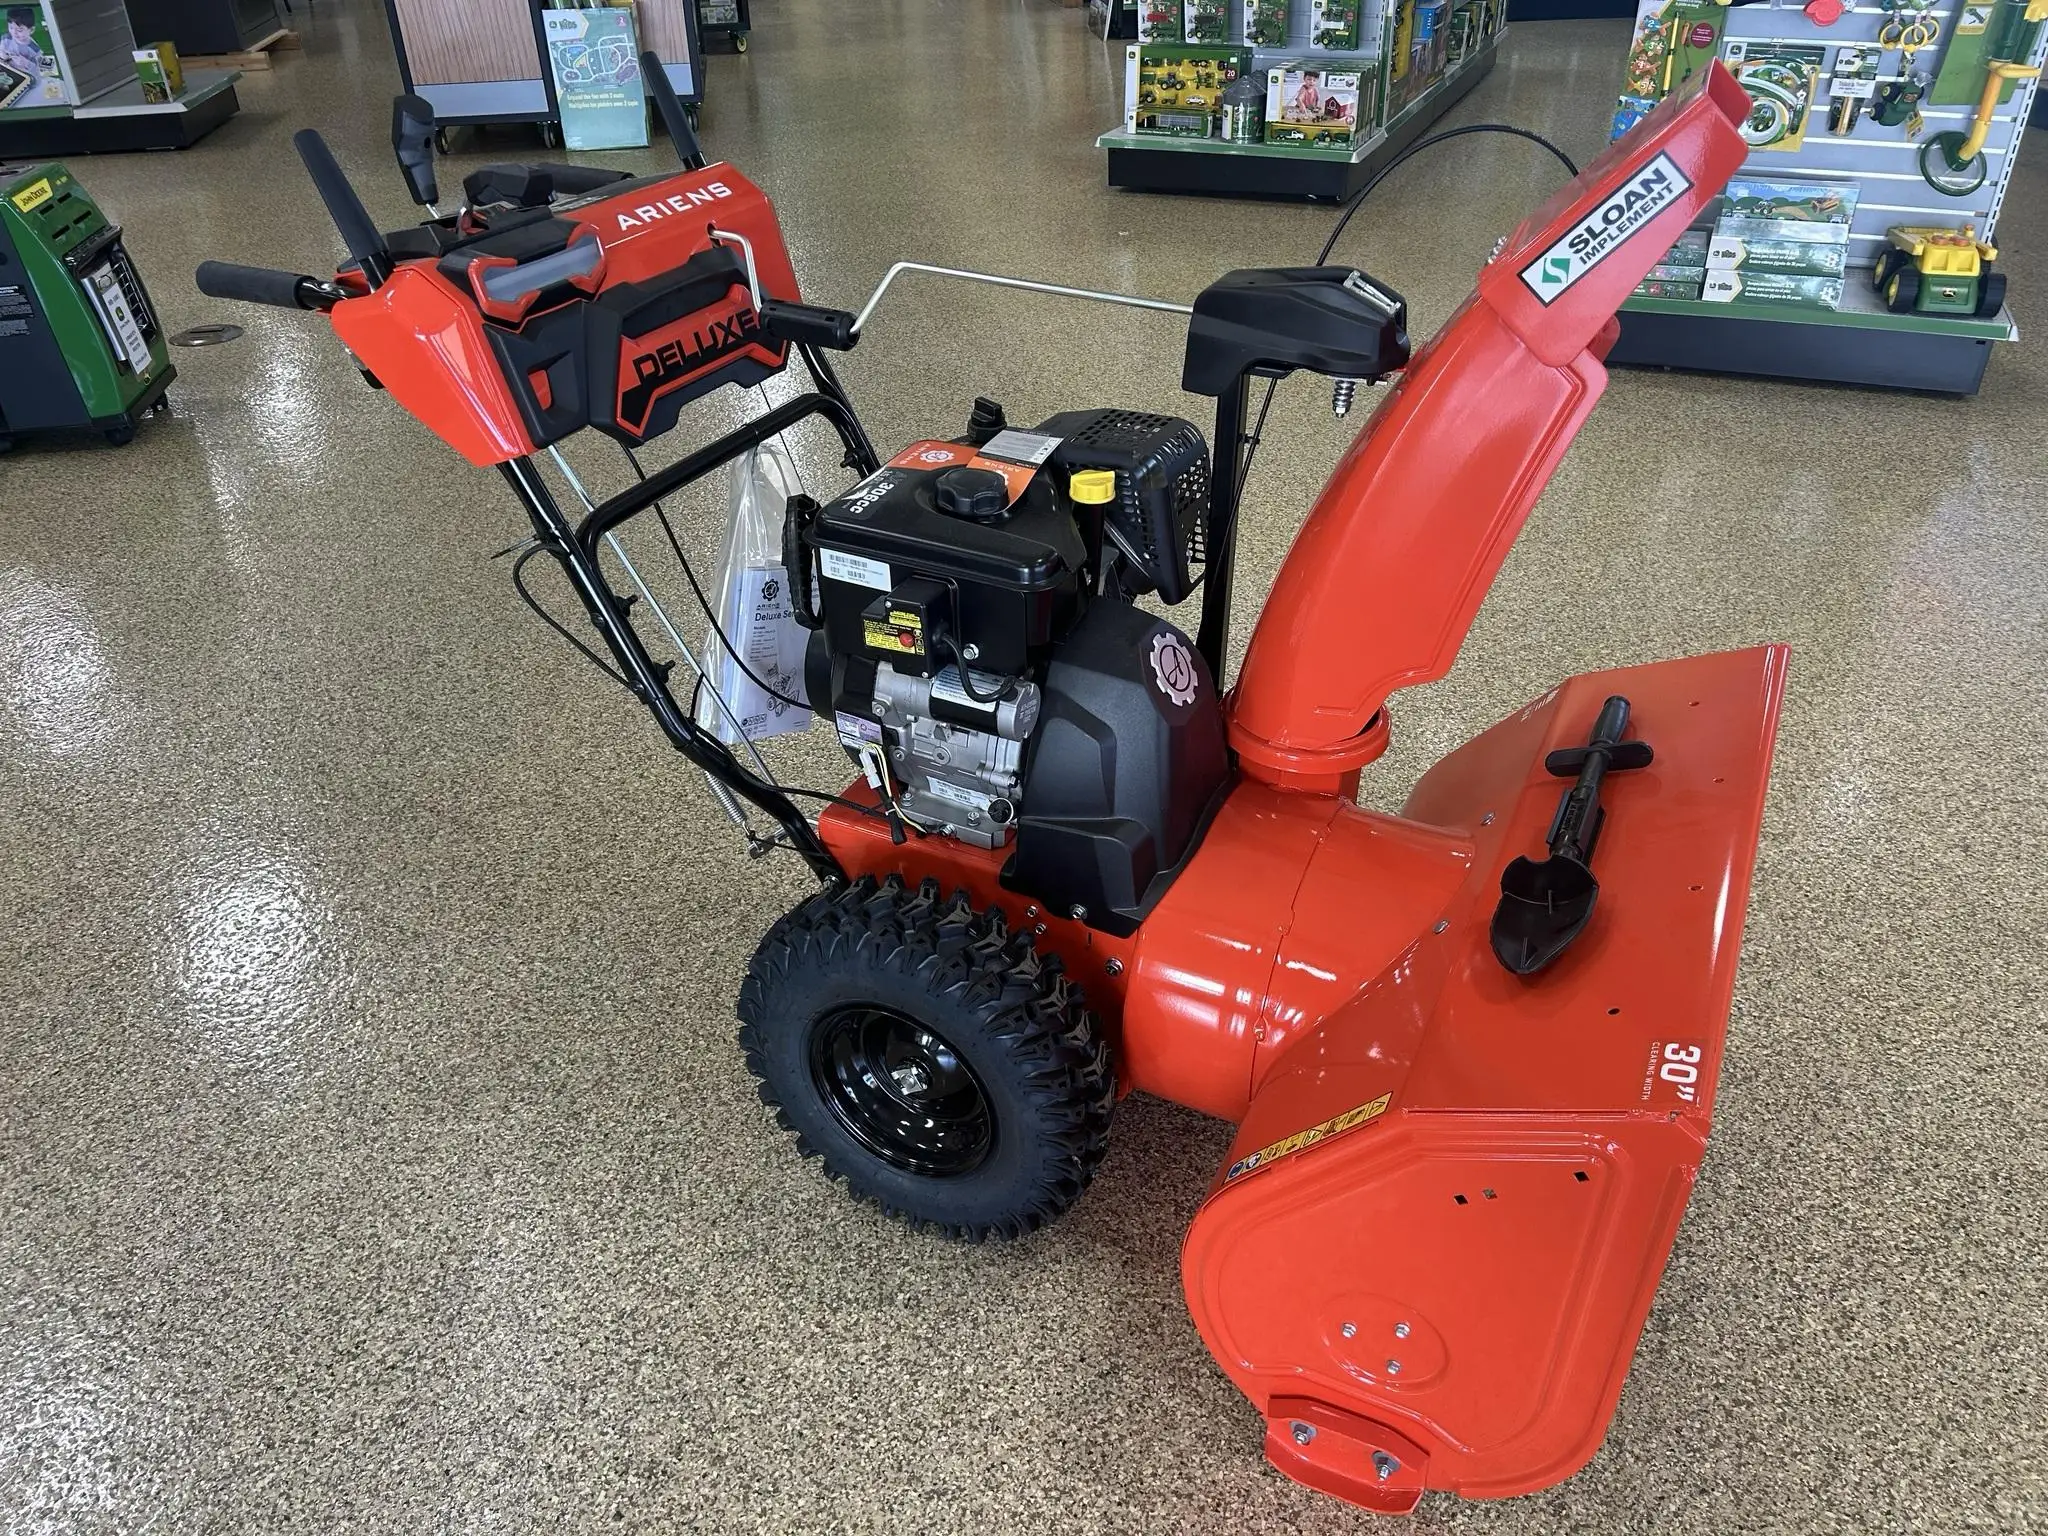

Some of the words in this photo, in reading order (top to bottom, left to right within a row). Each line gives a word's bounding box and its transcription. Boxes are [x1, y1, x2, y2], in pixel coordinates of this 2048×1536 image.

[617, 182, 733, 231] ARIENS
[1568, 167, 1668, 254] SLOAN
[1579, 181, 1674, 265] IMPLEMENT
[632, 308, 757, 383] DELUXE
[755, 612, 782, 622] Deluxe
[1646, 1041, 1660, 1075] CLEARING
[1641, 1077, 1653, 1100] WIDTH
